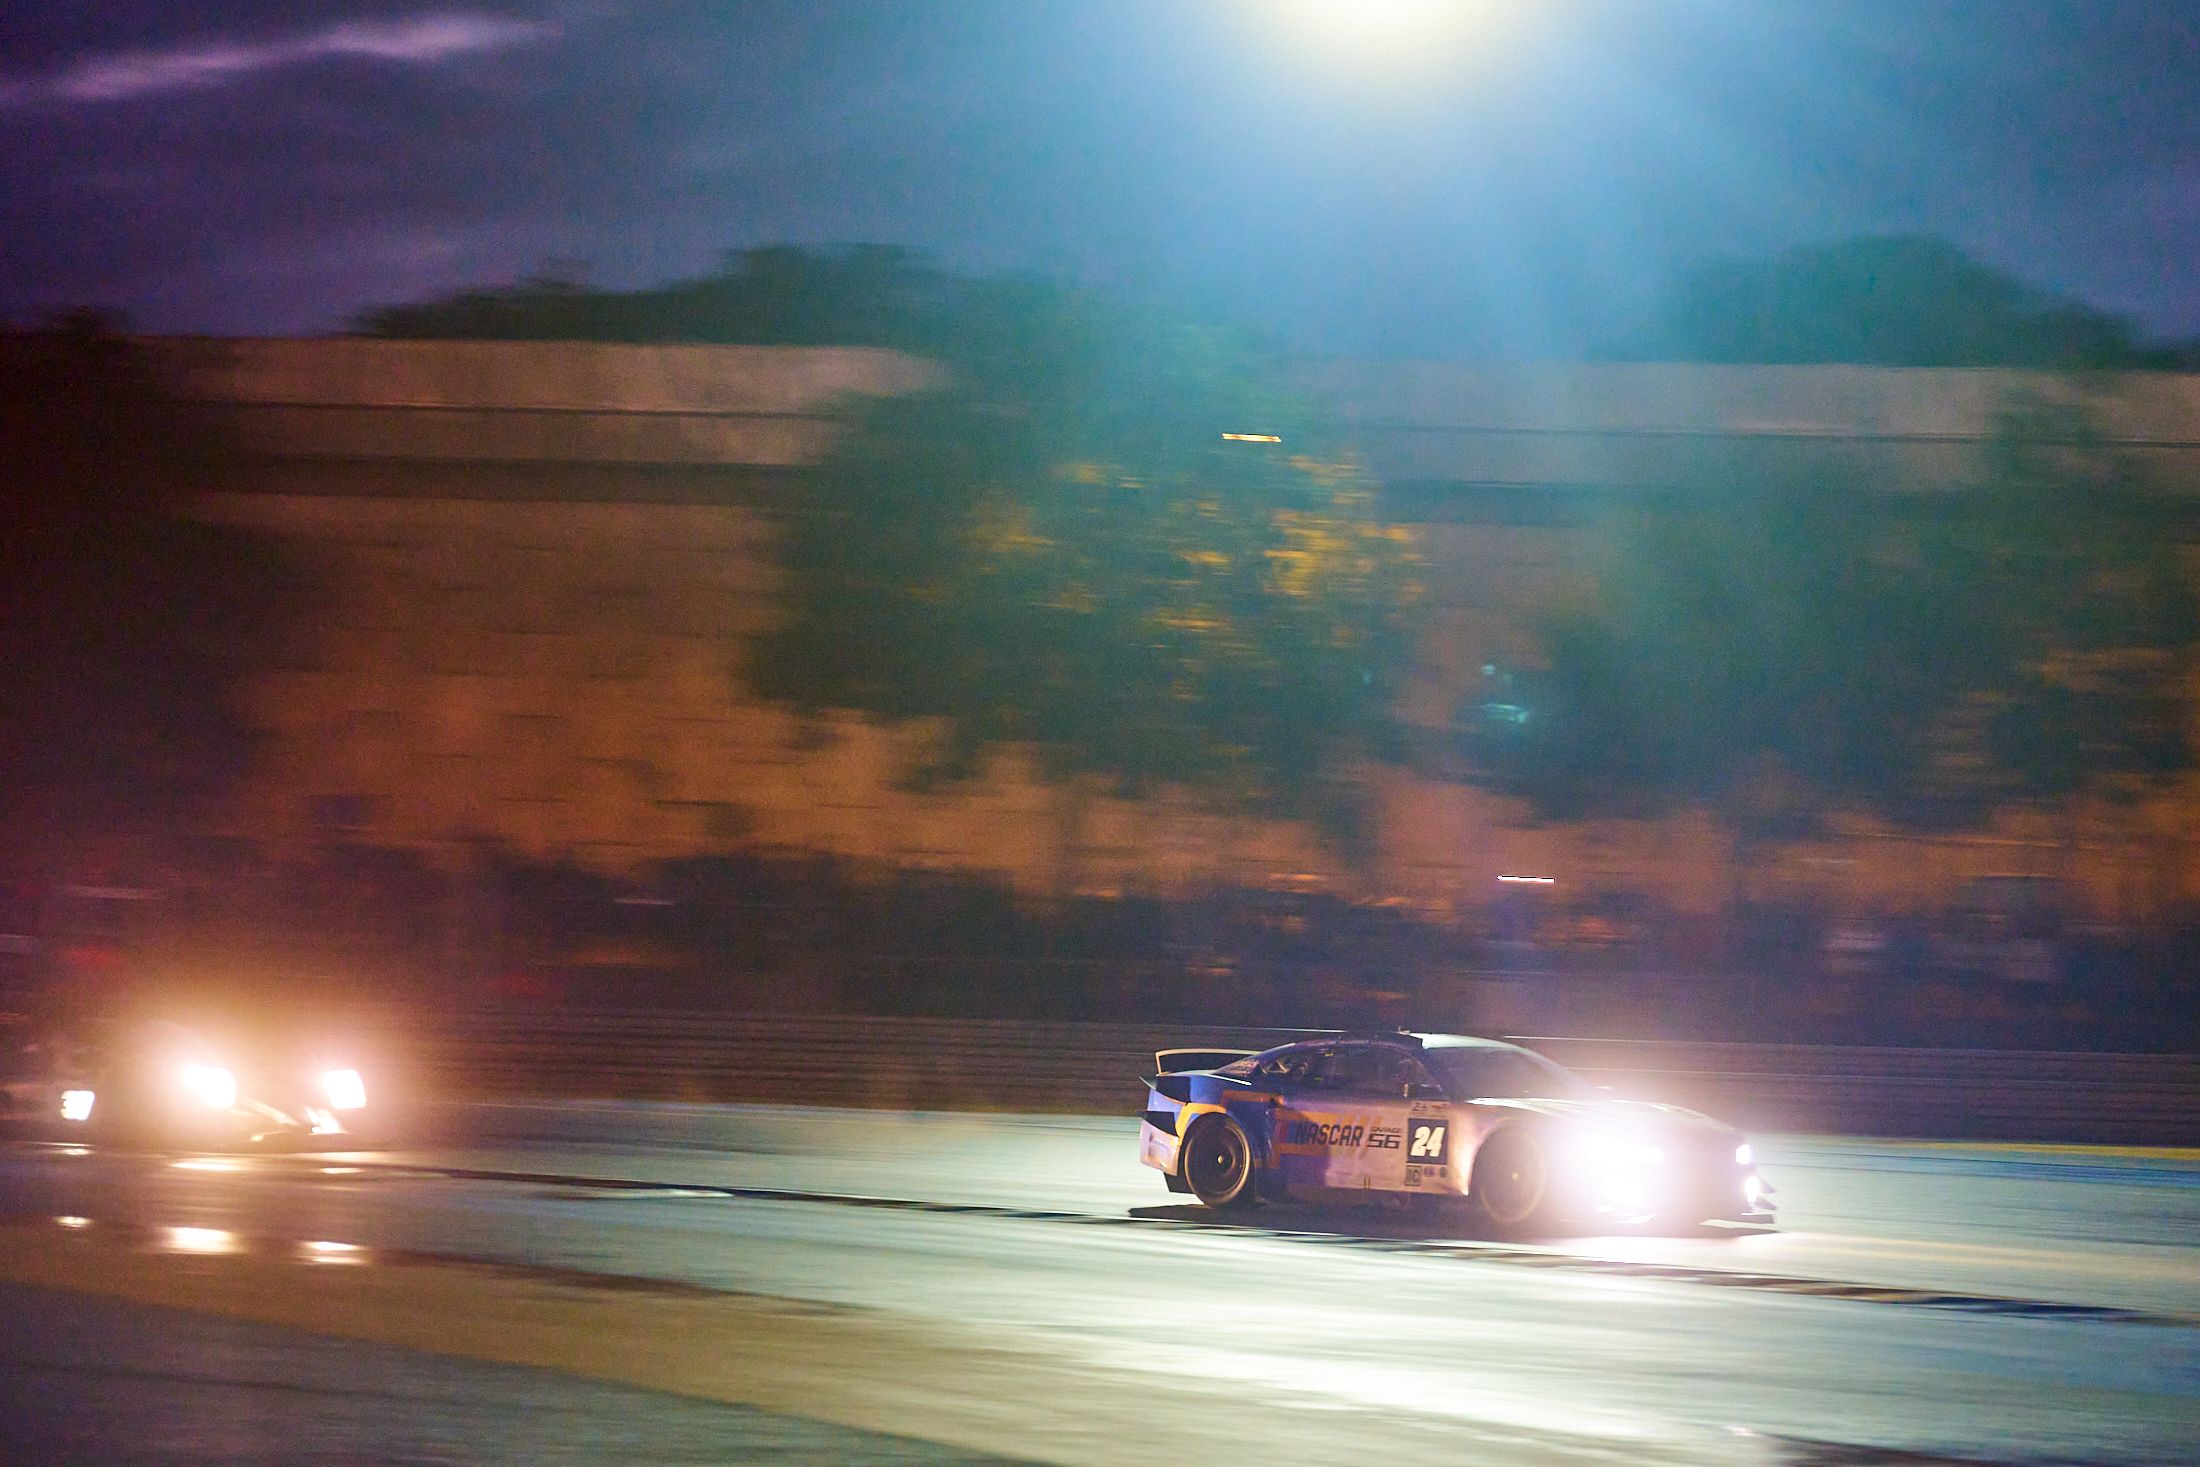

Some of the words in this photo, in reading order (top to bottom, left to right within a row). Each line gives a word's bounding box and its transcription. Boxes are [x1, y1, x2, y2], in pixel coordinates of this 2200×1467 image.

[1296, 1123, 1362, 1146] NASCAR
[1366, 1133, 1402, 1149] 56
[1410, 1126, 1445, 1157] 24
